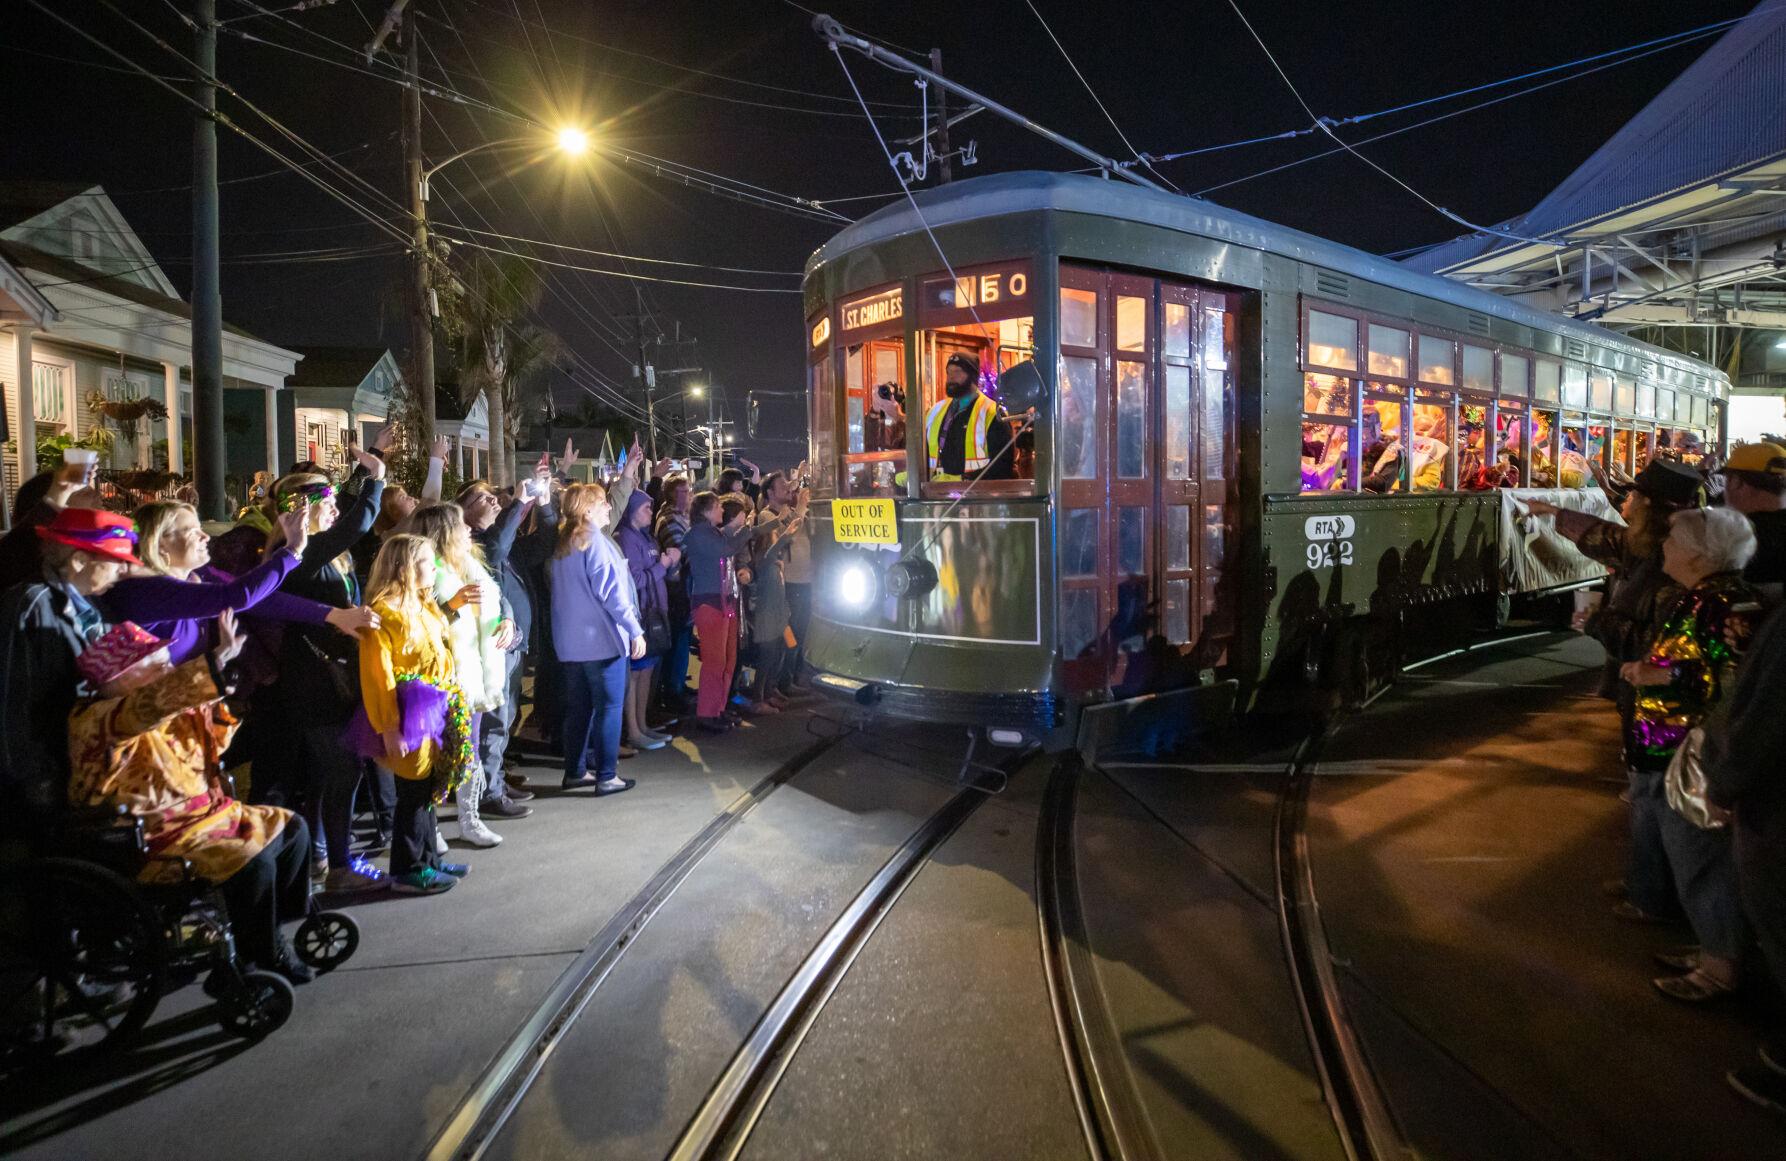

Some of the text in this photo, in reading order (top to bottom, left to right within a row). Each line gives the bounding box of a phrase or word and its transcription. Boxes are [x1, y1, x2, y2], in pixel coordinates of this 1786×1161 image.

[846, 296, 903, 330] ST. CHARLES
[841, 504, 884, 518] OUT OF
[840, 524, 890, 538] SERVICE
[1315, 521, 1334, 535] RTA
